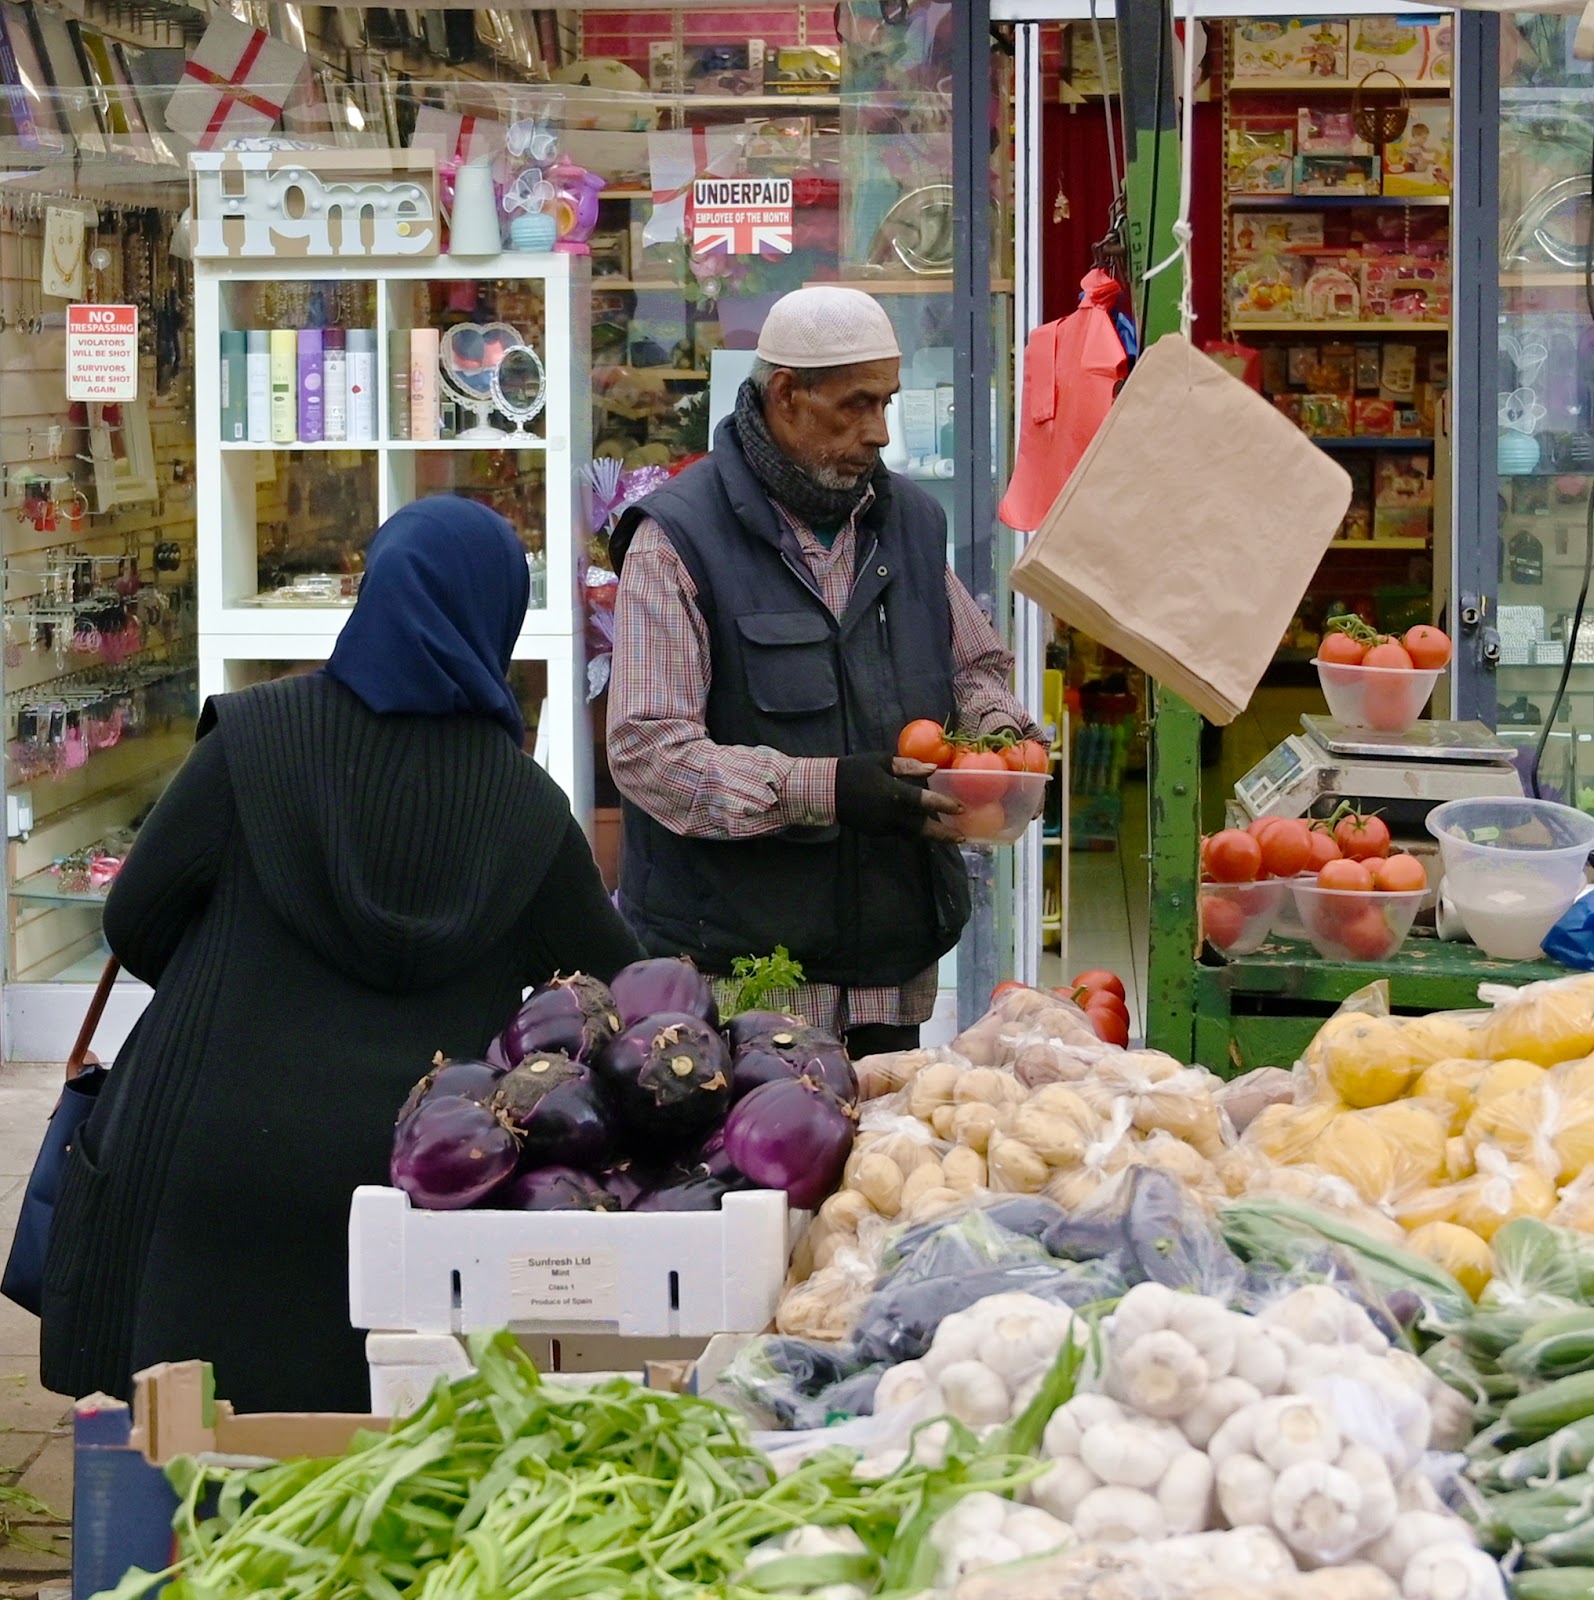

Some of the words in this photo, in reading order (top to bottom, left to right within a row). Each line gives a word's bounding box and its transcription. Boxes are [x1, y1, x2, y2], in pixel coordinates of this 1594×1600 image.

[695, 182, 790, 205] UNDERPAID
[190, 152, 434, 255] Home
[695, 212, 733, 224] EMPLOYEE
[735, 212, 745, 224] OF
[746, 212, 762, 223] THE
[763, 211, 789, 223] MONTH
[89, 311, 115, 323] NO
[70, 323, 134, 332] TRESPASSING
[78, 339, 126, 347] VIOLATORS
[77, 364, 126, 372] SURVIVORS
[108, 375, 131, 383] SHOT
[528, 1257, 573, 1267] Sunfresh
[575, 1256, 591, 1266] Ltd
[548, 1283, 569, 1291] Class
[530, 1298, 562, 1306] Produce
[572, 1297, 593, 1306] Spain
